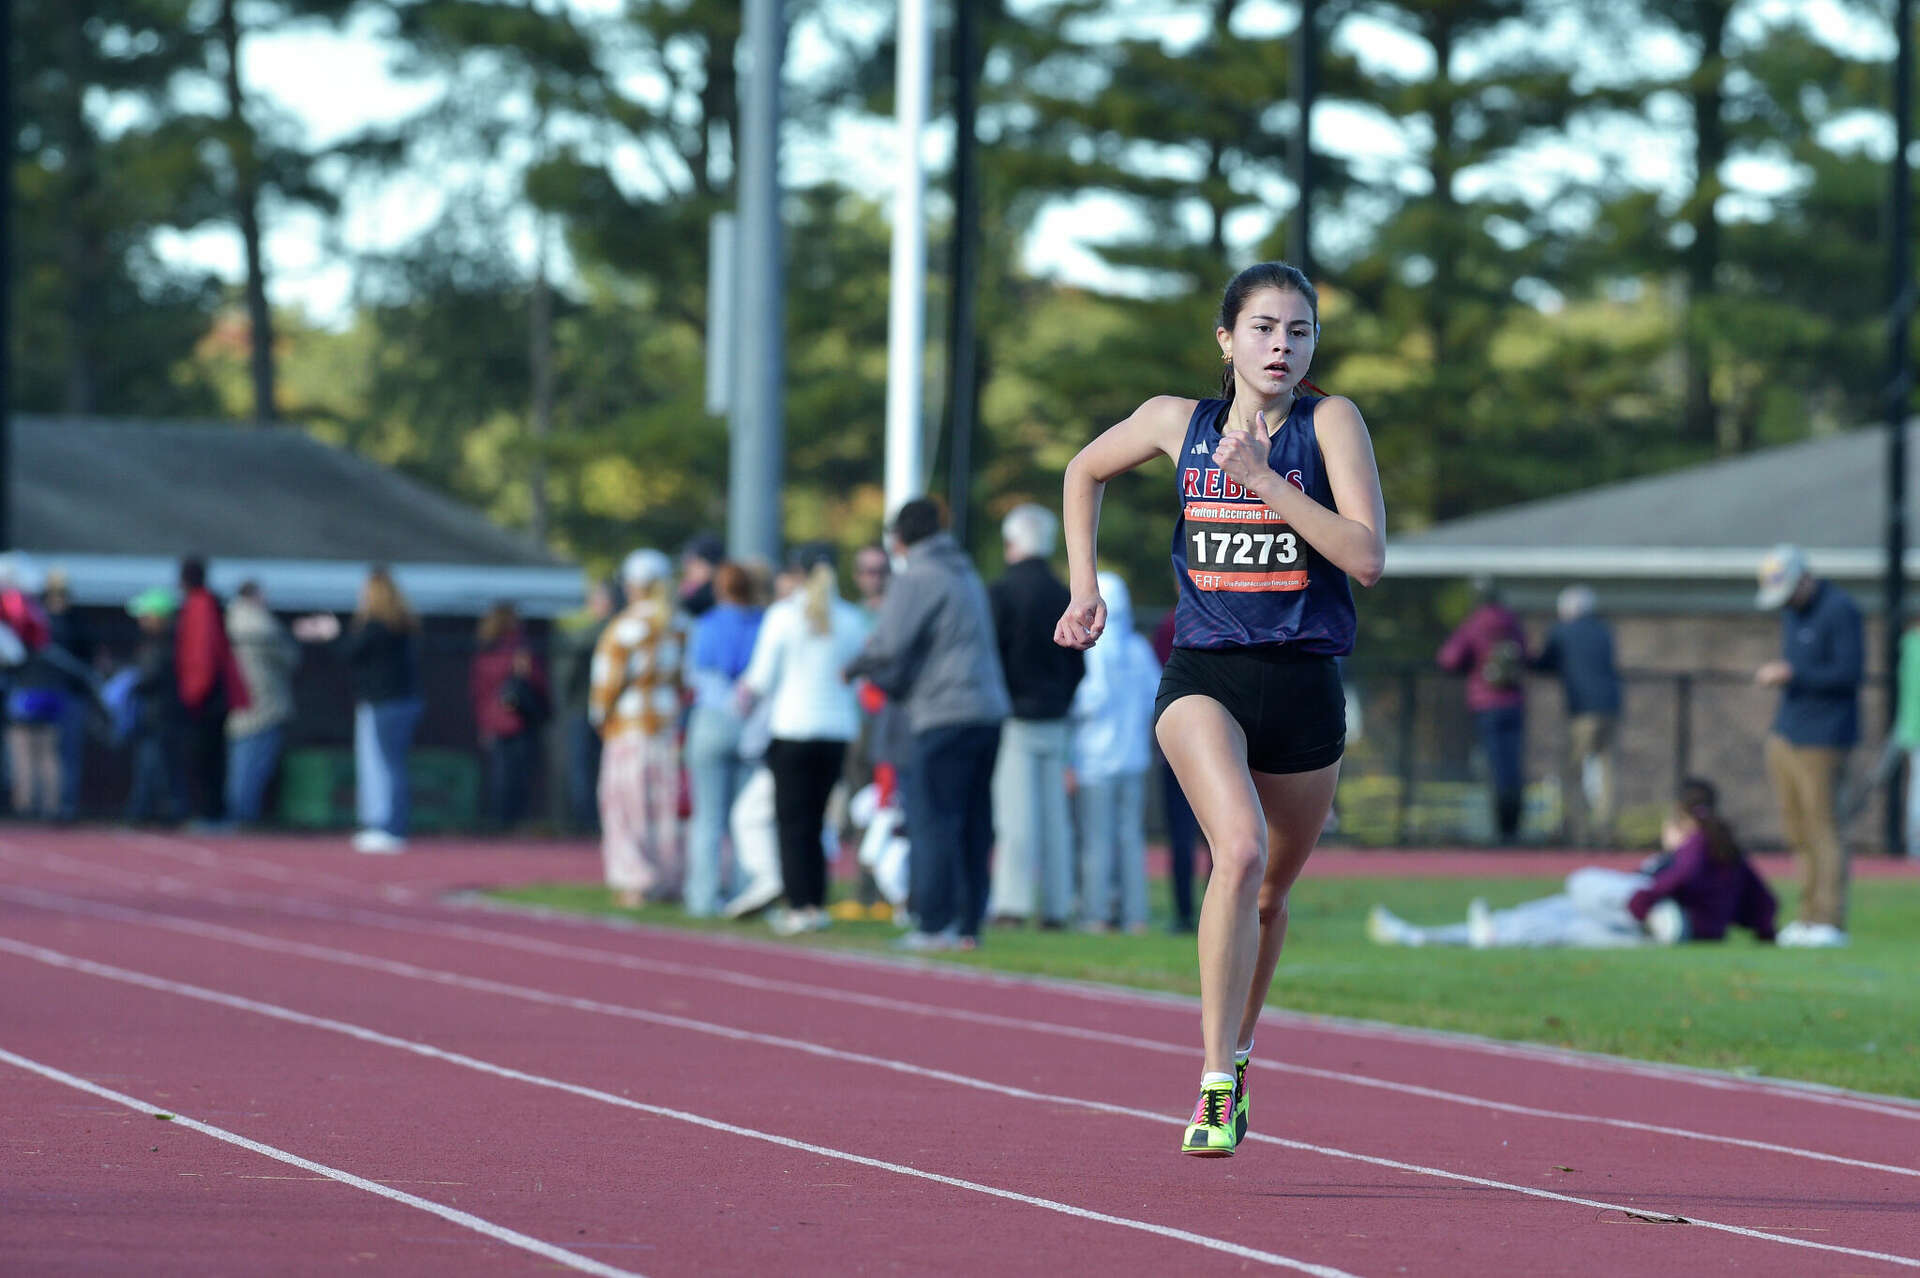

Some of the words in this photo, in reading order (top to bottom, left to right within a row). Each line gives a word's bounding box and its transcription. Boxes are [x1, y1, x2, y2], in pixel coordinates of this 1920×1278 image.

[1183, 467, 1305, 500] REBS
[1219, 508, 1262, 520] Accurate
[1192, 531, 1298, 565] 17273
[1195, 574, 1222, 588] FAT
